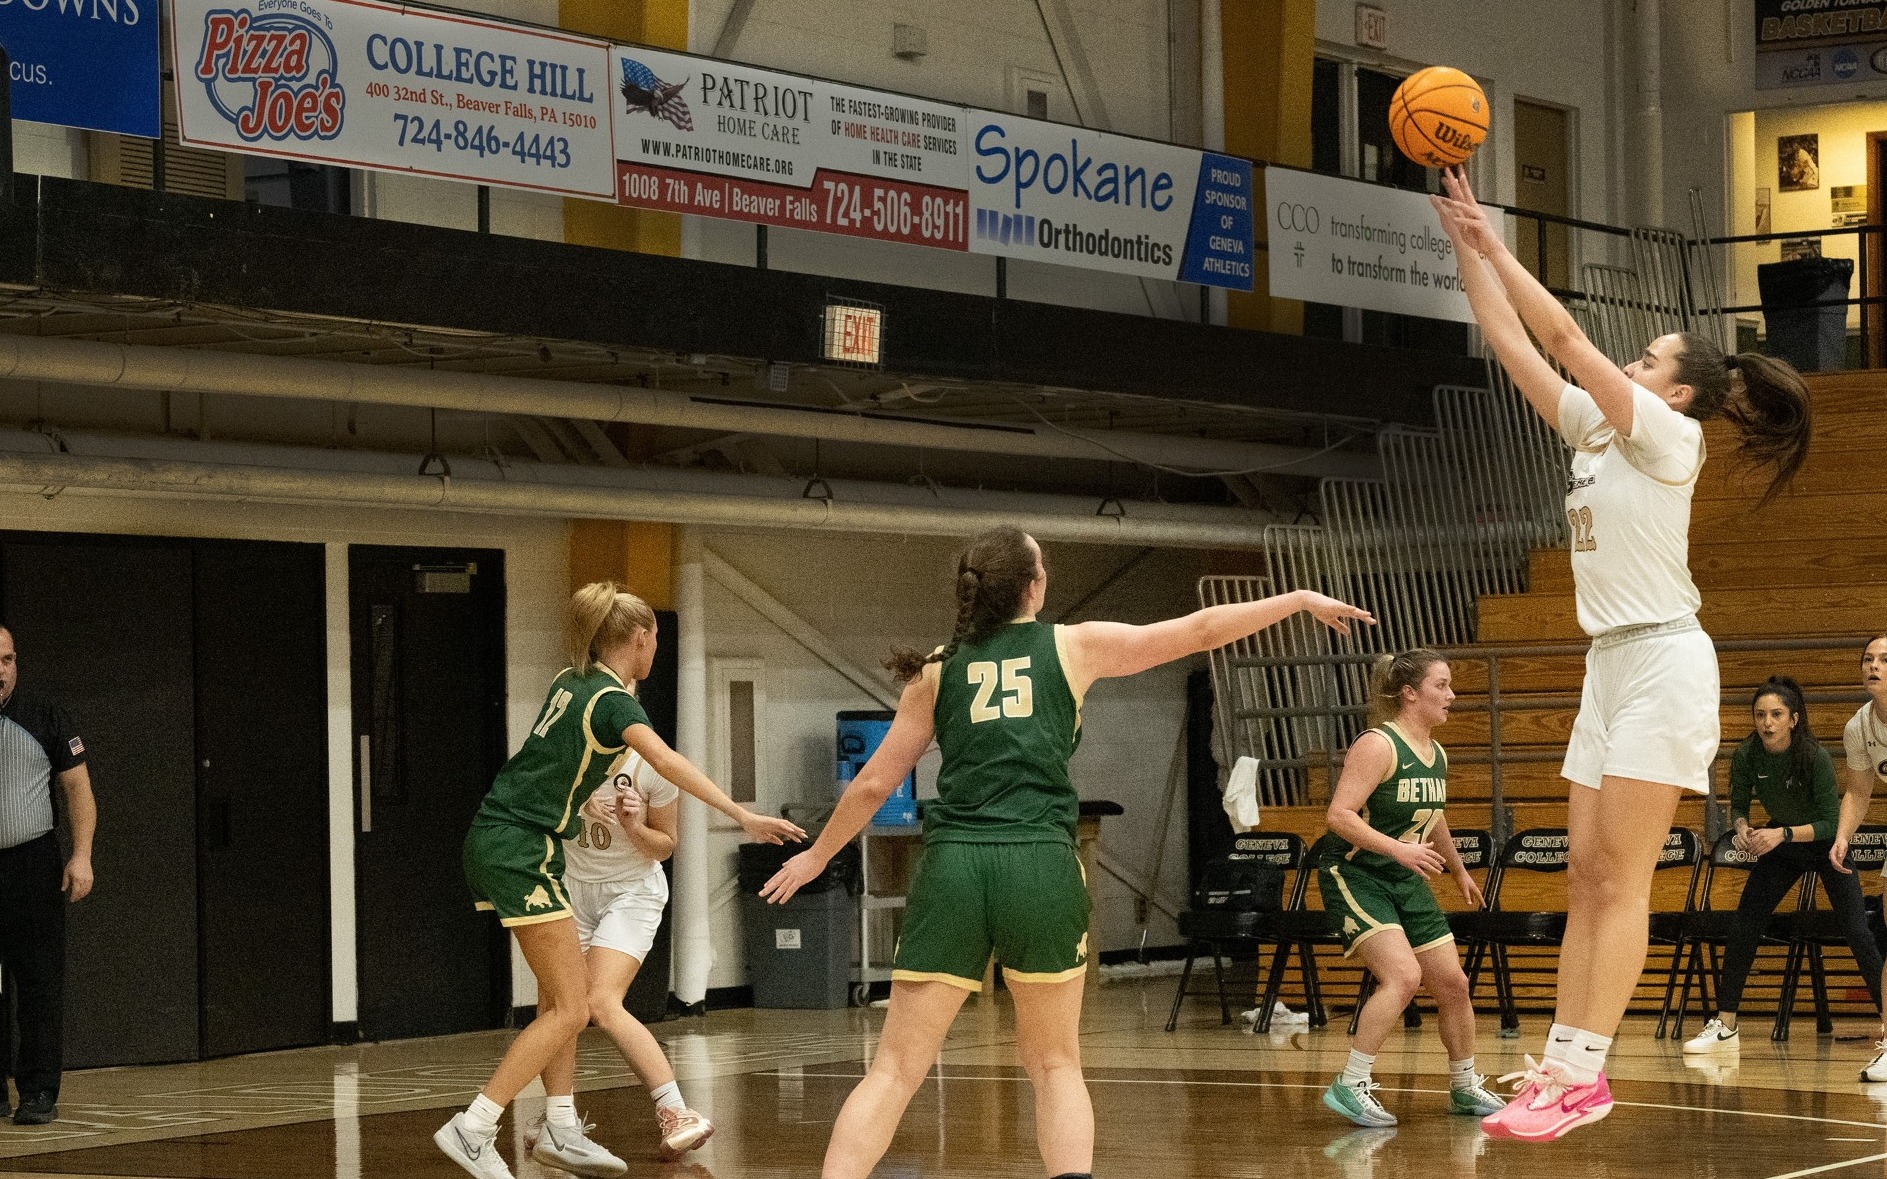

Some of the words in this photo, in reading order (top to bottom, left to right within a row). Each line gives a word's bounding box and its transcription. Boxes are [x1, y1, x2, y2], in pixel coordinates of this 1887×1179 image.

[258, 0, 298, 11] Everyone
[300, 1, 321, 21] Goes
[323, 14, 333, 30] To
[198, 14, 309, 78] Pizza
[366, 33, 519, 91] COLLEGE
[526, 58, 594, 104] HILL
[238, 76, 343, 136] Joe's
[365, 81, 390, 98] 400
[393, 85, 427, 104] 32nd
[430, 89, 453, 111] St.,
[456, 93, 501, 115] Beaver
[504, 100, 537, 124] Falls,
[540, 106, 558, 123] PA
[562, 111, 597, 130] 15010
[701, 72, 813, 123] PATRIOT
[830, 96, 846, 113] THE
[848, 99, 919, 125] FASTEST-GROWING
[921, 112, 957, 133] PROVIDER
[393, 112, 571, 169] 724-846-4443
[717, 114, 756, 137] HOME
[761, 122, 801, 145] CARE
[831, 119, 841, 136] OF
[844, 121, 867, 140] HOME
[870, 125, 899, 145] HEALTH
[901, 131, 921, 149] CARE
[923, 135, 957, 155] SERVICES
[641, 138, 794, 176] WWW.PATRIOTHOMECARE.ORG
[872, 149, 880, 165] IN
[883, 151, 898, 167] THE
[900, 153, 922, 171] STATE
[975, 124, 1174, 212] Spokane
[1211, 168, 1241, 187] PROUD
[622, 172, 659, 200] 1008
[665, 179, 688, 204] 7th
[694, 182, 720, 209] Ave
[732, 187, 780, 217] Beaver
[786, 195, 818, 222] Falls
[823, 180, 963, 242] 724-506-8911
[1205, 189, 1247, 211] SPONSOR
[1220, 215, 1234, 230] OF
[1277, 201, 1320, 234] CCO
[1038, 218, 1173, 266] Orthodontics
[1209, 235, 1244, 254] GENEVA
[1331, 214, 1407, 255] transforming
[1410, 225, 1452, 260] college
[1203, 257, 1249, 277] ATHLETICS
[1331, 252, 1344, 274] to
[1347, 254, 1406, 284] transform
[1410, 261, 1429, 287] the
[843, 314, 875, 356] EXIT
[1568, 505, 1597, 553] 22
[966, 656, 1033, 723] 25
[577, 818, 612, 850] 10
[1235, 838, 1289, 850] GENEVA
[1521, 836, 1569, 848] GENEV
